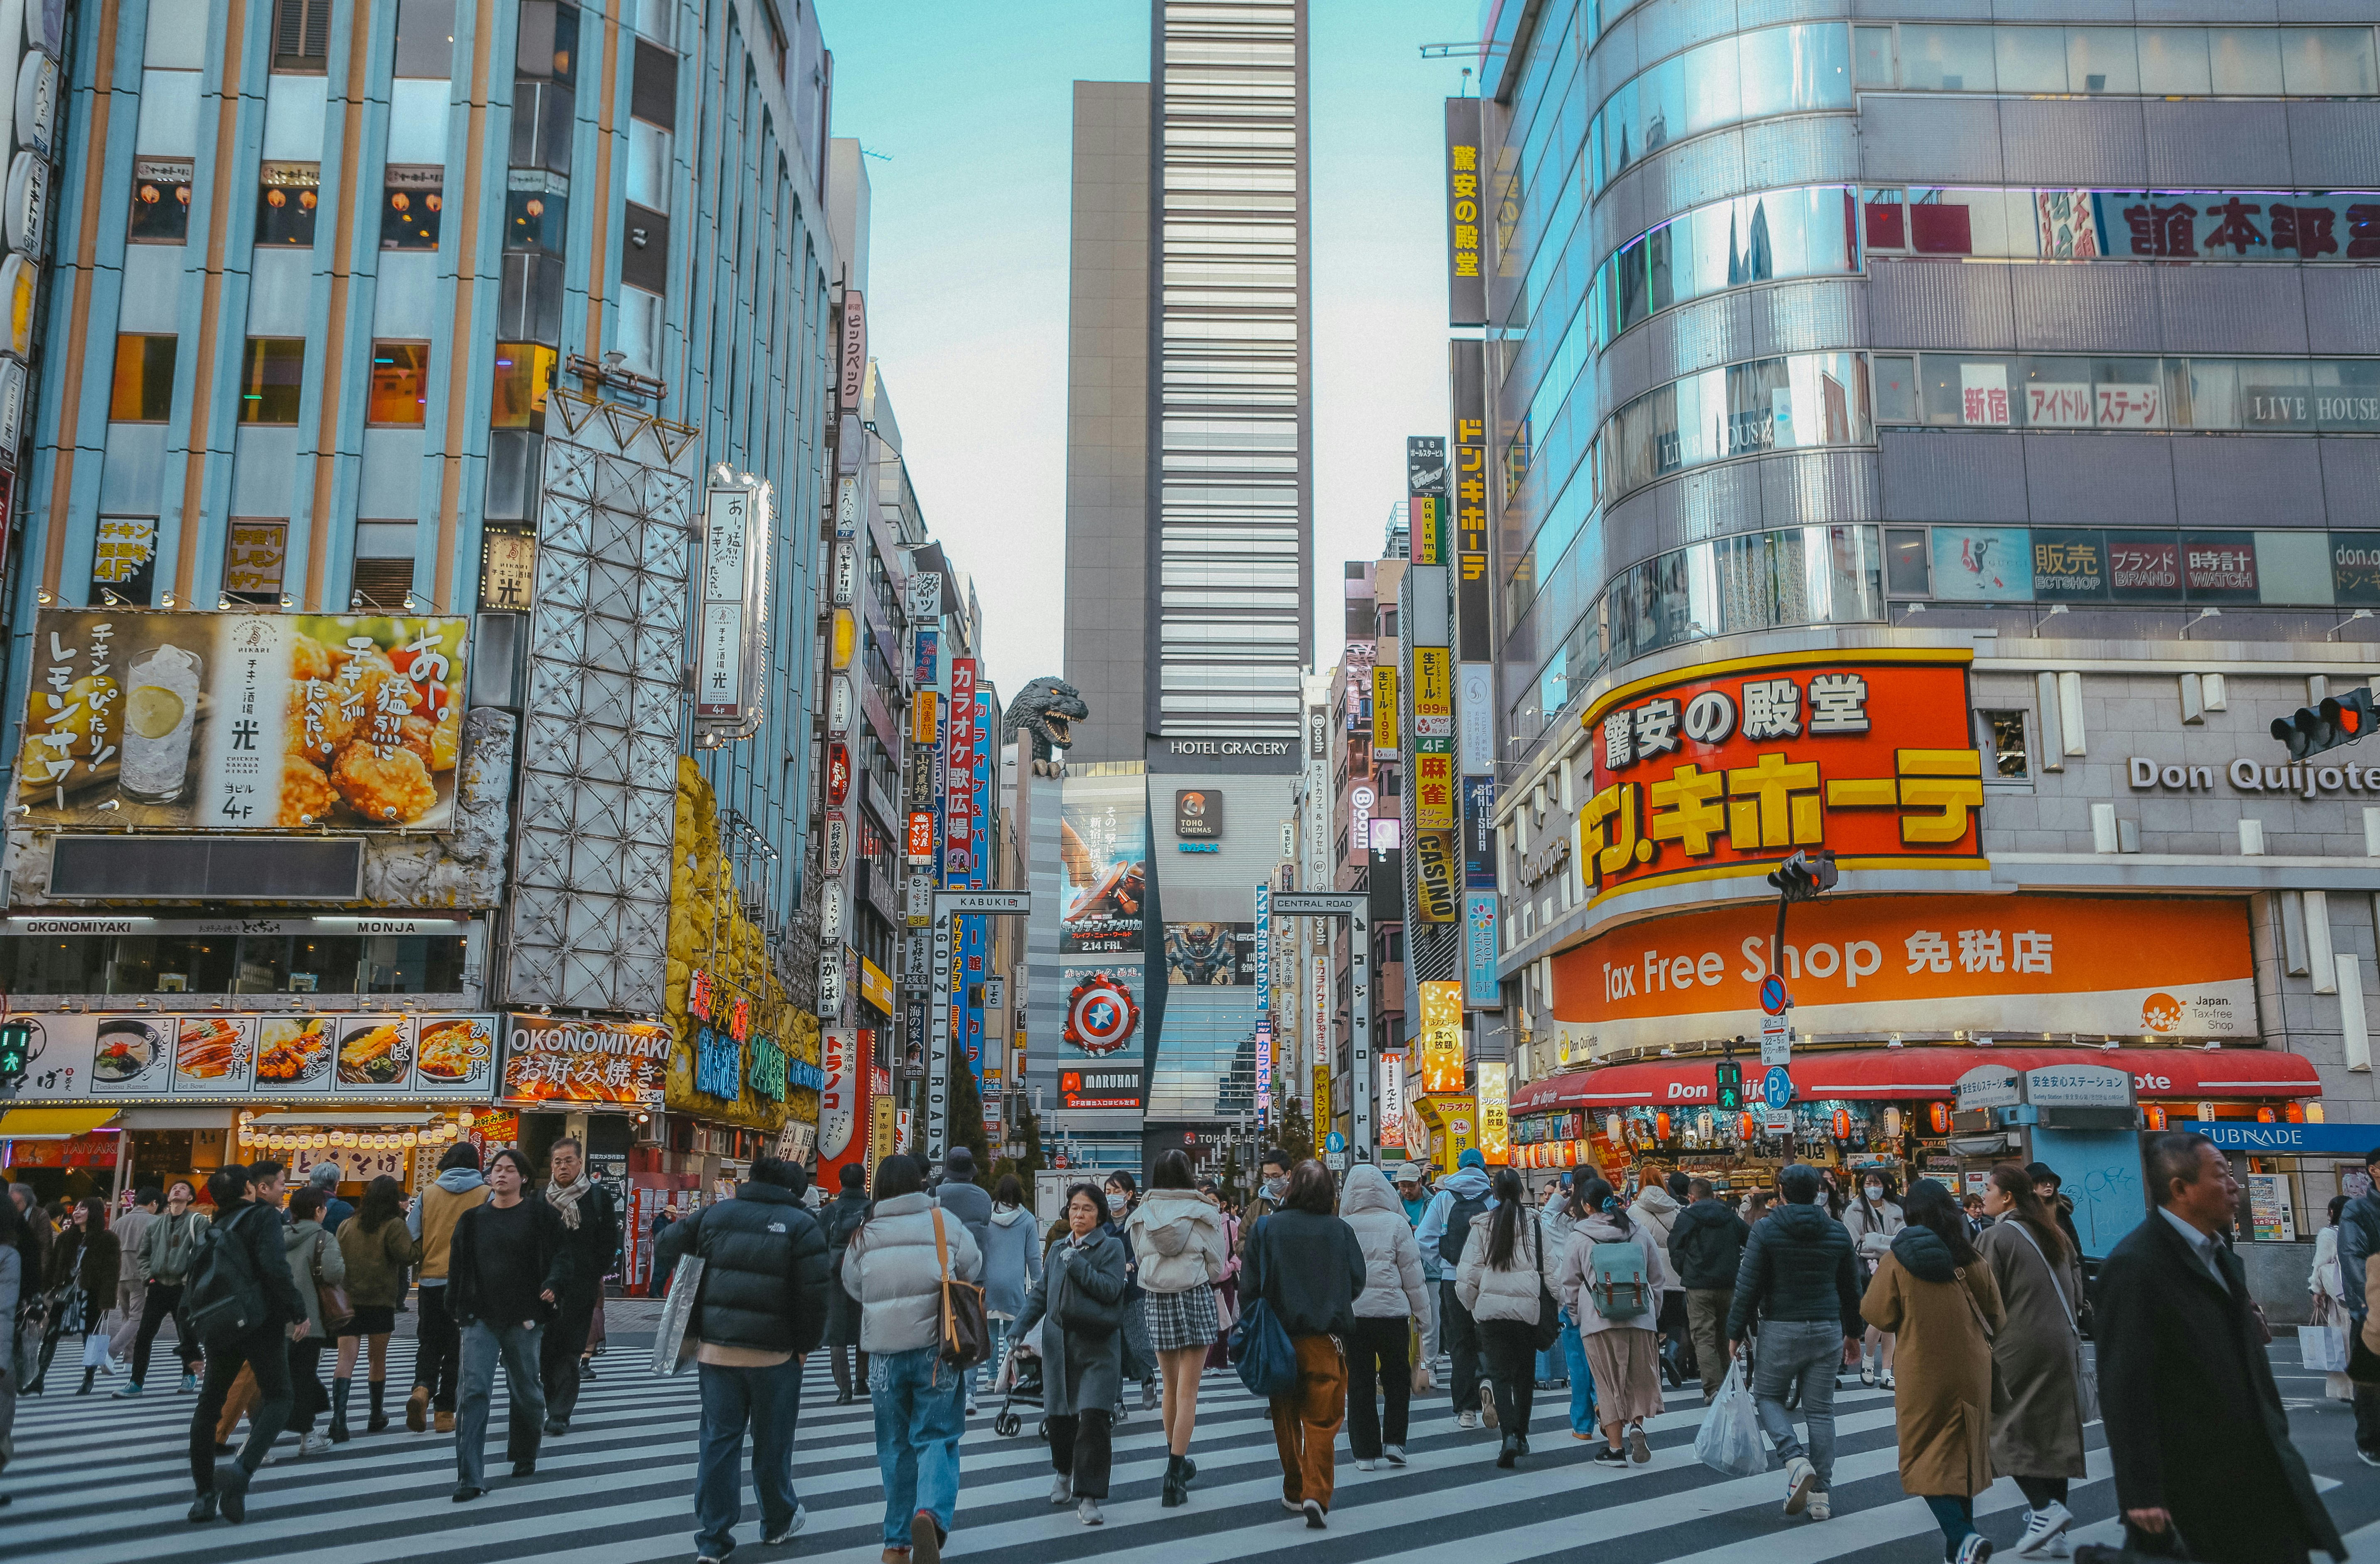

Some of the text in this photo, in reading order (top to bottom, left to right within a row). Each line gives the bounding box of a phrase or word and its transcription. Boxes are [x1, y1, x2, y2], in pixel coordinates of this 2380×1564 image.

[1452, 145, 1479, 278] 驚安の殿堂
[1964, 387, 2009, 425] 新宿
[2030, 390, 2090, 422] アイドル
[2100, 391, 2157, 423] ステージ
[2255, 397, 2379, 420] LIVE HOUSE
[841, 493, 854, 528] うさぎや
[101, 522, 155, 539] チキン
[1423, 501, 1435, 550] Garam
[95, 559, 132, 582] 4F
[231, 549, 283, 569] レモン
[1989, 559, 2031, 570] GUCCI
[2035, 543, 2099, 576] 販売
[2112, 552, 2175, 571] ブランド
[2188, 551, 2250, 571] 時計
[229, 571, 280, 590] サワー
[492, 569, 532, 580] チキン酒場
[2035, 576, 2100, 591] ECTSHOP
[2115, 571, 2176, 588] BRAND
[2189, 572, 2252, 588] WATCH
[498, 578, 521, 605] 光
[836, 593, 851, 602] 6F
[716, 628, 726, 669] チキン酒場
[916, 640, 937, 681] 海の家
[242, 659, 257, 715] チキン酒場
[341, 637, 373, 722] チキンが
[712, 672, 728, 690] 光
[1423, 652, 1436, 700] 生ビール
[1378, 672, 1389, 709] 生ビール
[42, 631, 81, 811] レモンサワー
[304, 676, 333, 754] たべたい。
[373, 679, 412, 761] 猛烈に
[712, 704, 725, 714] 4F
[834, 713, 843, 724] 光
[1417, 704, 1449, 714] 199円
[1603, 672, 1871, 770] 驚安の殿堂
[231, 720, 260, 751] 光
[1381, 711, 1389, 745] 199円
[949, 667, 972, 840] カラオケ歌広場
[1170, 741, 1289, 756] HOTEL GRACERY
[1422, 739, 1444, 752] 4F
[916, 754, 930, 795] 山内農場
[1421, 757, 1447, 805] 麻雀
[2128, 757, 2380, 799] Don Quijote
[224, 781, 255, 795] 当ビル
[221, 796, 253, 820] 4F
[1477, 785, 1487, 852] SHISHA
[1419, 818, 1451, 827] ファイブ
[830, 822, 841, 868] お好み焼き
[1089, 817, 1102, 884] 新宿が揺らぐ。
[1179, 843, 1220, 852] IMAX
[915, 856, 926, 865] 4F
[1524, 837, 1564, 888] Don Quijote
[1417, 834, 1454, 917] CASINO
[828, 894, 838, 935] とらそば
[961, 898, 1018, 907] KABUKI町
[1278, 900, 1323, 908] CENTRAL
[27, 921, 131, 933] OKONOMIYAKI
[357, 922, 416, 933] MONJA
[913, 916, 925, 925] 3F
[1082, 941, 1123, 951] 2.14 FRI.
[1257, 891, 1269, 1006] 747カラオケランド
[1474, 931, 1484, 969] STAGE
[1483, 932, 1492, 963] IDOL
[1904, 929, 2054, 975] 免税店
[906, 975, 927, 984] 大阪家
[1065, 967, 1143, 979] 赤いハルク、暴走。
[1603, 934, 1883, 1002] Tax Free Shop
[821, 963, 837, 1000] かっぱ
[1475, 981, 1492, 993] 5F
[822, 1004, 834, 1012] B1
[1315, 965, 1327, 1063] カラオケ まねきねこ
[2191, 1008, 2233, 1020] Tax-free
[2196, 996, 2232, 1007] Japan.
[909, 1005, 922, 1039] 海の家
[1428, 1018, 1459, 1026] ポップコーン
[2208, 1020, 2234, 1032] Shop
[390, 1021, 409, 1062] そば
[511, 1030, 673, 1061] OKONOMIYAKI
[929, 933, 948, 1139] GODZILLA ROAD
[1353, 953, 1367, 1126] ゴジラロード
[1434, 1041, 1453, 1050] 放題
[1570, 1035, 1598, 1053] Don Quijote
[139, 1030, 155, 1082] ラーメン
[226, 1020, 248, 1080] うな丼
[465, 1022, 491, 1082] かつ丼
[843, 1031, 854, 1074] 大衆酒場
[302, 1052, 318, 1078] 定食
[520, 1055, 656, 1089] お好み焼き
[824, 1035, 843, 1110] トラノコ
[1085, 1074, 1139, 1089] MARUHAN
[1667, 1082, 1708, 1099] Don
[2032, 1075, 2123, 1089] 安全安心ステーション
[1438, 1103, 1473, 1112] カラオケ
[1776, 1091, 1785, 1102] 40
[1487, 1108, 1504, 1117] 飲み
[1453, 1122, 1468, 1131] 24H
[2198, 1127, 2303, 1147] SUBNADE
